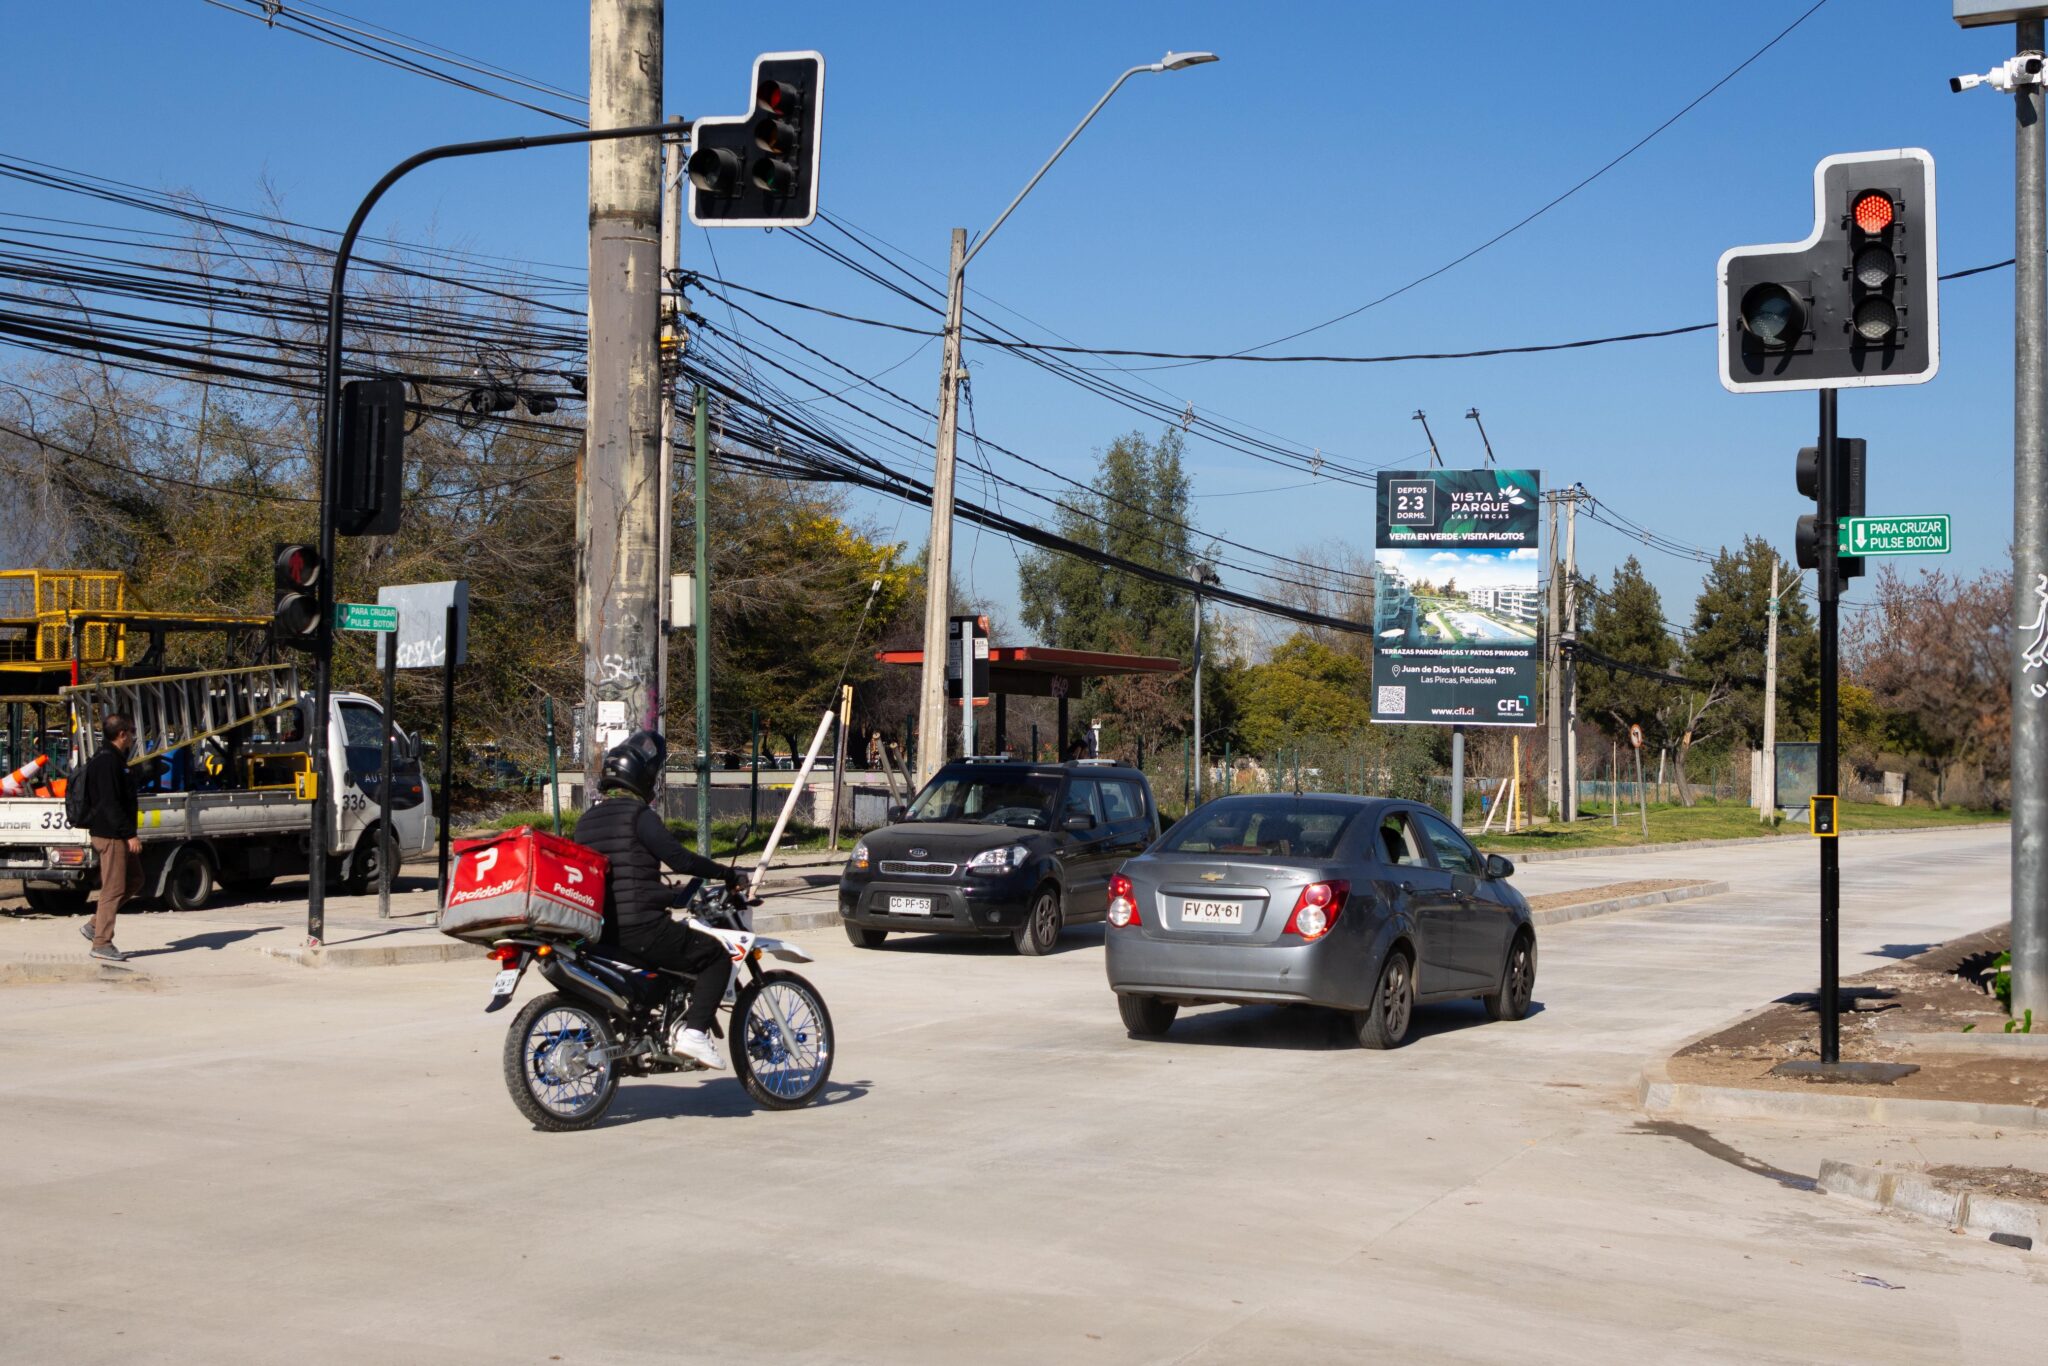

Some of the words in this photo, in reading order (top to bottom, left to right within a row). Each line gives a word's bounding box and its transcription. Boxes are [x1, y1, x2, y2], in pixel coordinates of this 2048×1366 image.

[1397, 486, 1427, 494] DEPTOS
[1451, 492, 1493, 501] VISTA
[1451, 502, 1509, 512] PARQUE
[1869, 522, 1898, 534] PARA
[1900, 521, 1942, 533] CRUZAR
[1389, 532, 1418, 540] VENTA
[1419, 532, 1430, 540] EN
[1430, 532, 1459, 540] VERDE
[1462, 532, 1490, 540] VISITA
[1489, 532, 1525, 540] PILOTOS
[1870, 536, 1904, 548] PULSE
[1906, 534, 1943, 548] BOTÓN
[351, 607, 369, 616] PARA
[370, 608, 396, 617] CRUZAR
[350, 618, 370, 627] PULSE
[1415, 647, 1463, 656] PANORÁMICAS
[1401, 665, 1421, 673] Juan
[1421, 665, 1432, 673] de
[1433, 665, 1450, 673] Dios
[1451, 665, 1467, 674] Vial
[1468, 666, 1494, 674] Correa
[1495, 666, 1517, 676] 4219,
[1421, 676, 1433, 684] Las
[1434, 676, 1458, 685] Pircas,
[1460, 676, 1497, 685] Peñalolén
[1497, 699, 1524, 711] CFL
[1431, 707, 1475, 716] www.cfl.cl
[342, 793, 367, 811] 336
[452, 879, 516, 905] PedidosYa
[553, 882, 596, 907] PedidosYa
